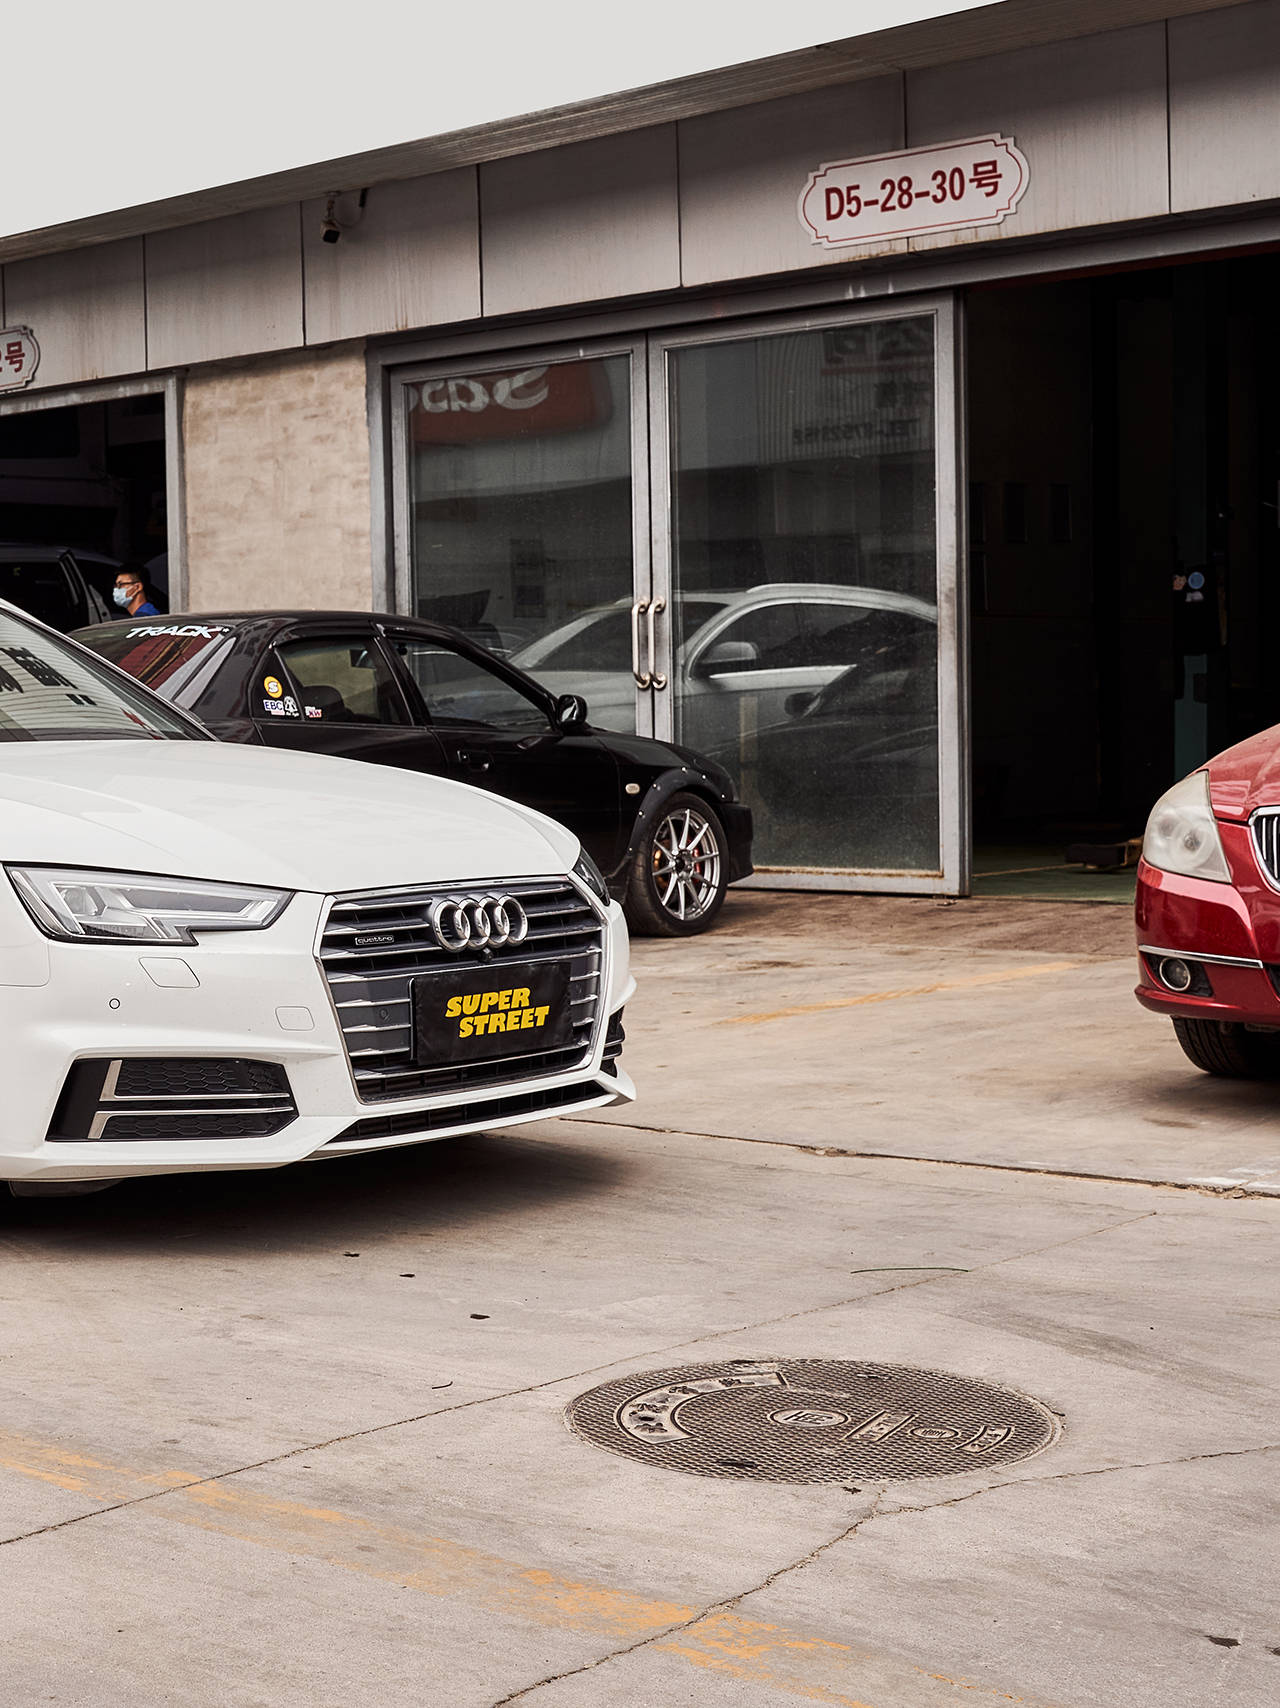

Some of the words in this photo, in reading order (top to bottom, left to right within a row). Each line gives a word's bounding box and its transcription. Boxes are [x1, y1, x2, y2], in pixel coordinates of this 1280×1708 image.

[824, 159, 1003, 222] D5-28-30号
[126, 625, 220, 639] TRACK
[264, 701, 283, 711] EBC
[445, 987, 531, 1018] SUPER
[458, 1005, 550, 1038] STREET
